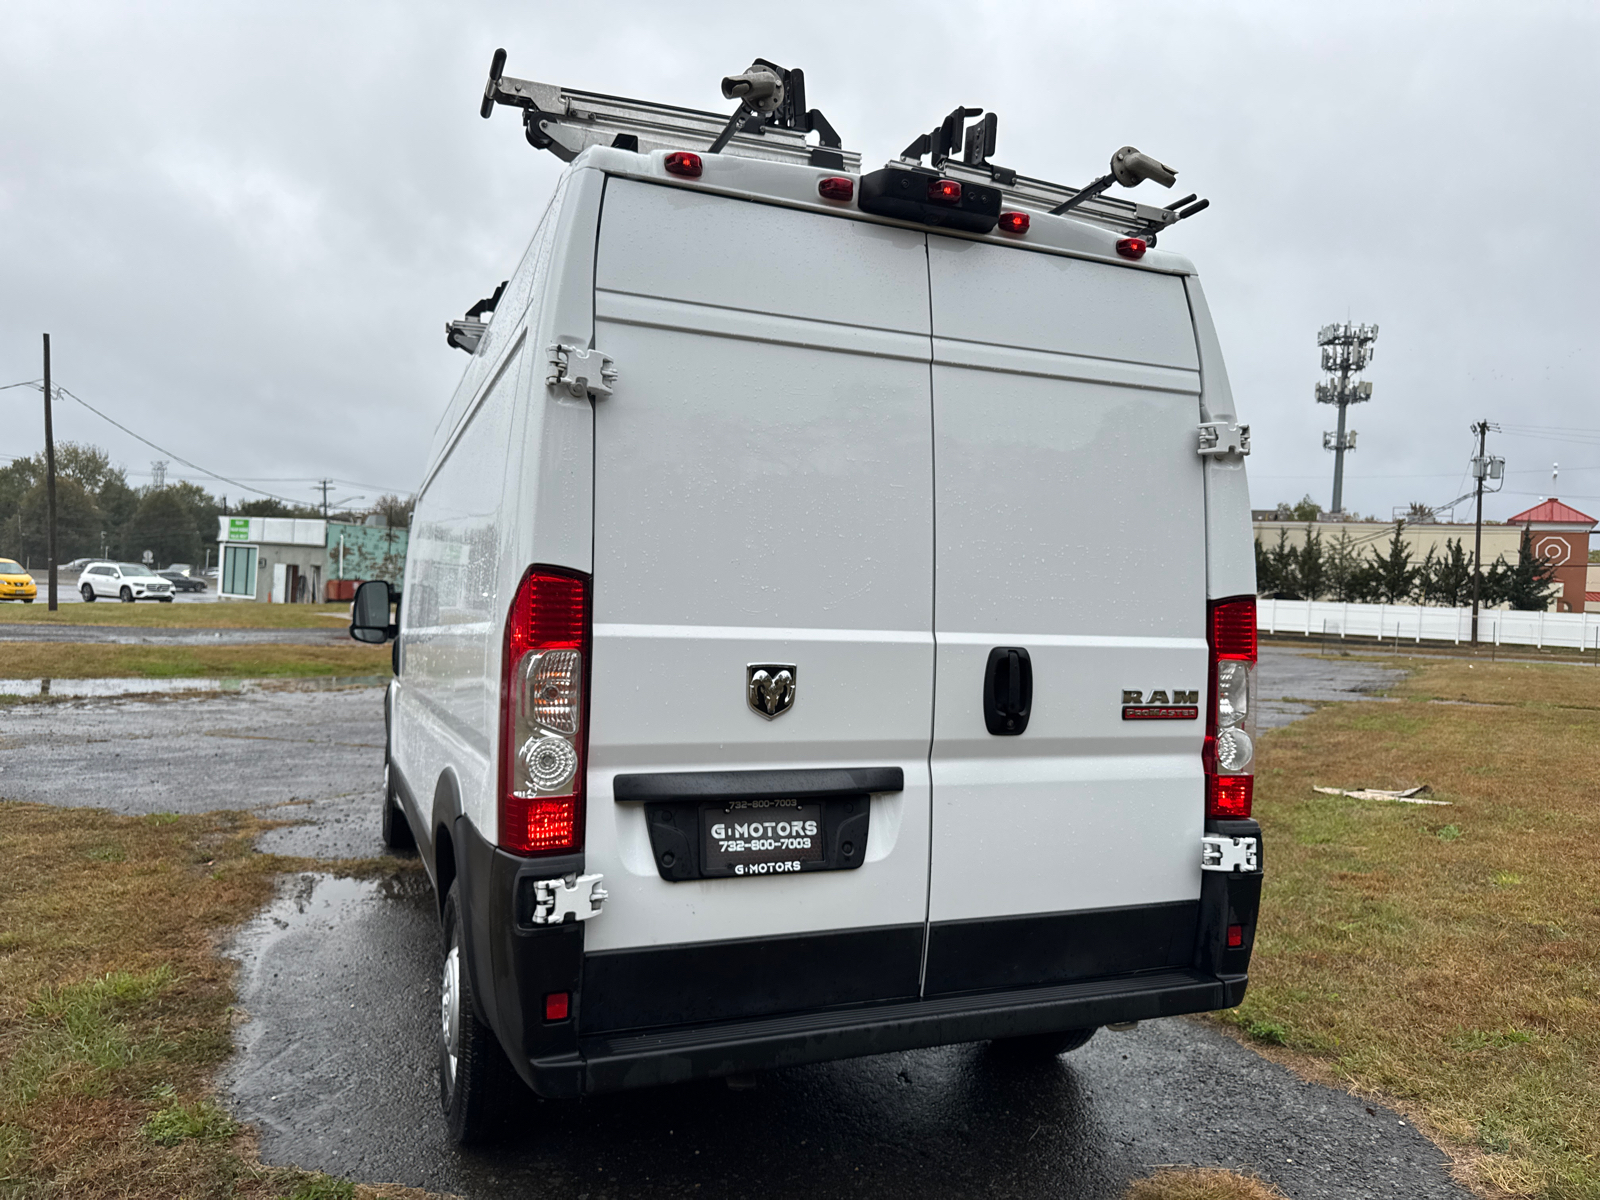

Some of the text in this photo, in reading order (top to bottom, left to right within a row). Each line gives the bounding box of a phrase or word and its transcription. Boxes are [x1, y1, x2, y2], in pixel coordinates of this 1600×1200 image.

[1122, 689, 1199, 704] RAM
[729, 799, 797, 809] 732-800-7003
[719, 838, 811, 852] 732-800-7003
